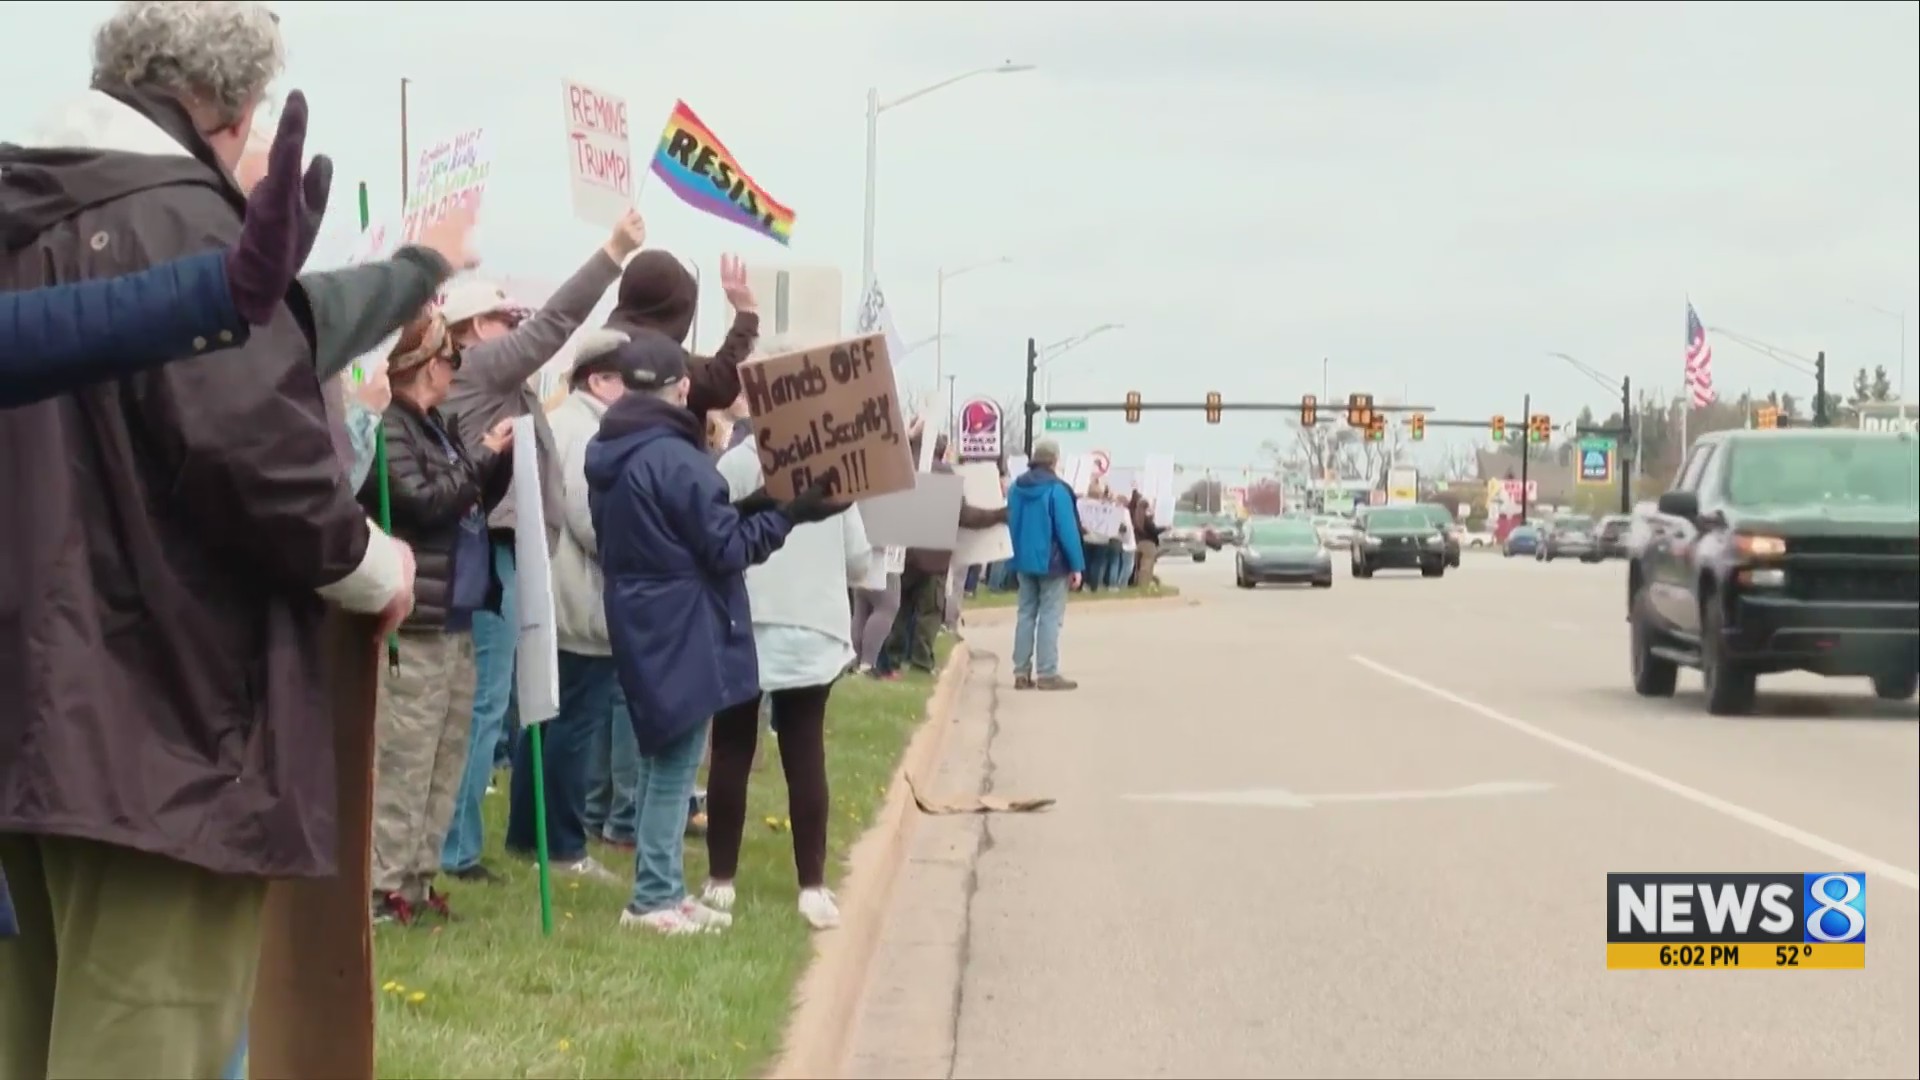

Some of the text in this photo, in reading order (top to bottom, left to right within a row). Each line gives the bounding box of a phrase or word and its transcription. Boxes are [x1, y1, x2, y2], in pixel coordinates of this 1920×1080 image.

[570, 86, 628, 139] REMOVE
[572, 132, 630, 194] TRUMP!
[741, 353, 827, 416] Hands
[759, 420, 822, 476] Social
